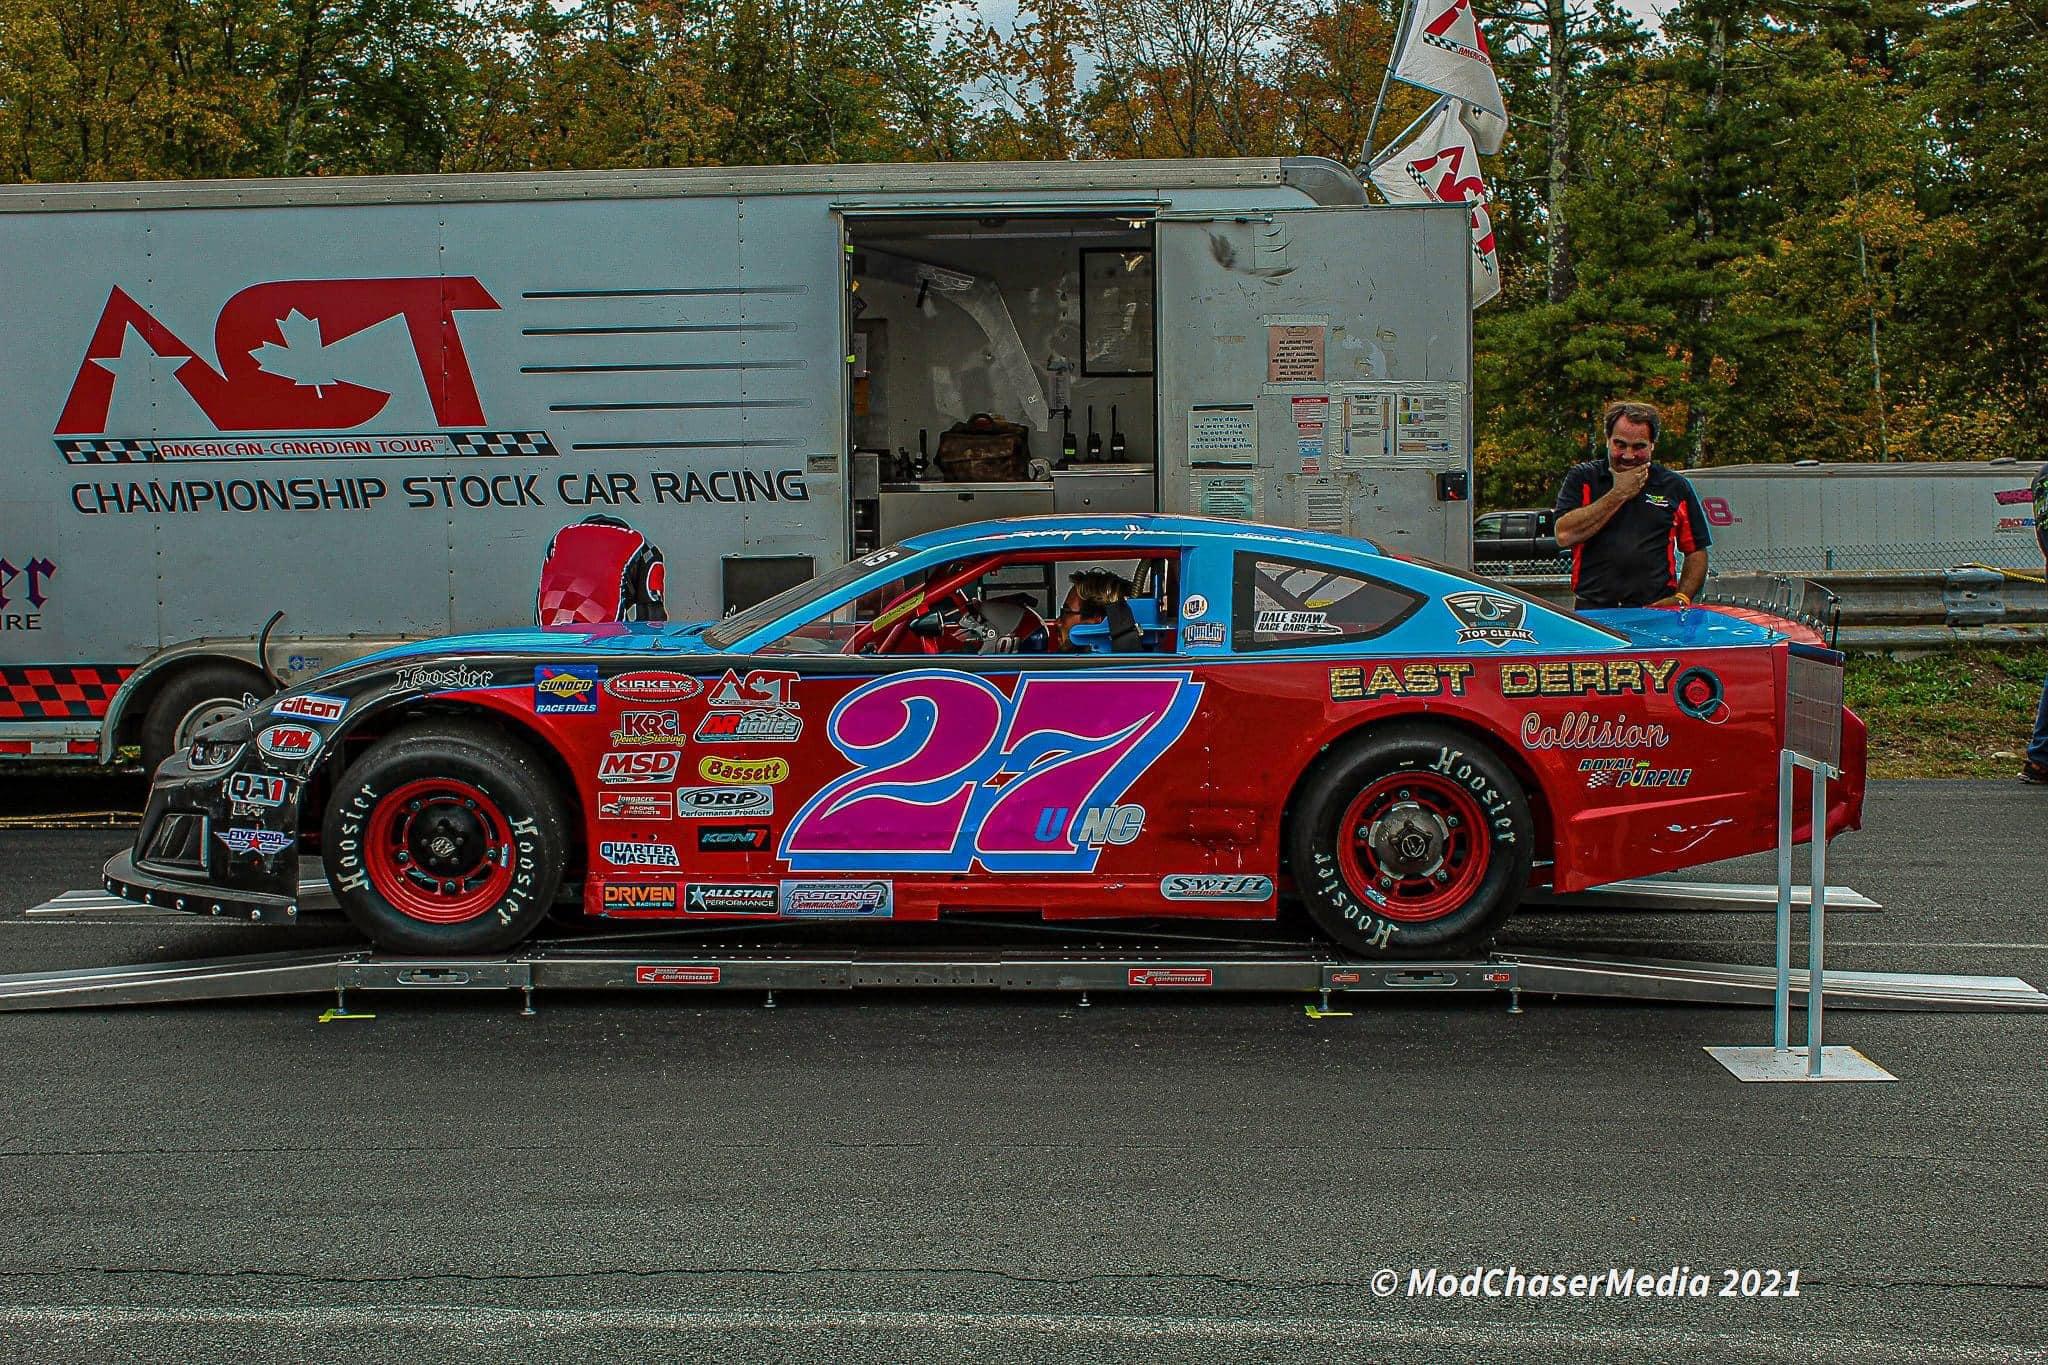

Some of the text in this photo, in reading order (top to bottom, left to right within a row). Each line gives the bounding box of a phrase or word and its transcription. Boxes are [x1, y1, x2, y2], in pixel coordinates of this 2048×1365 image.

[54, 275, 502, 434] ACT
[378, 439, 433, 454] TOUR
[71, 469, 810, 514] CHAMPIONSHIP STOCK CAR RACING
[1260, 612, 1325, 623] DALE SHAW
[1257, 622, 1307, 631] RACE CARS
[1463, 629, 1527, 639] TOP CLEAN
[389, 664, 494, 690] Hoosier
[616, 679, 682, 689] KIRKEY
[1330, 659, 1680, 702] EAST DERRY
[538, 680, 593, 692] SUNOCO
[708, 668, 801, 703] ACT
[536, 703, 598, 714] RACE FUELS
[622, 711, 678, 737] KRC
[1520, 711, 1670, 750] Collision
[602, 752, 677, 775] MSD
[706, 759, 783, 782] Bassett
[777, 668, 1205, 873] 27
[1578, 757, 1636, 772] ROYAL
[1615, 766, 1693, 788] PURPLE
[693, 791, 759, 807] DRP
[734, 808, 771, 816] Products
[229, 830, 284, 844] FIVE STAR
[336, 784, 377, 893] Hoosier
[601, 842, 673, 857] QUARTER
[614, 853, 678, 866] MASTER
[498, 815, 539, 926] Hoosier
[1169, 877, 1267, 893] Swift
[605, 886, 676, 904] DRIVEN
[704, 888, 775, 899] ALLSTAR
[704, 899, 775, 907] PERFORMANCE
